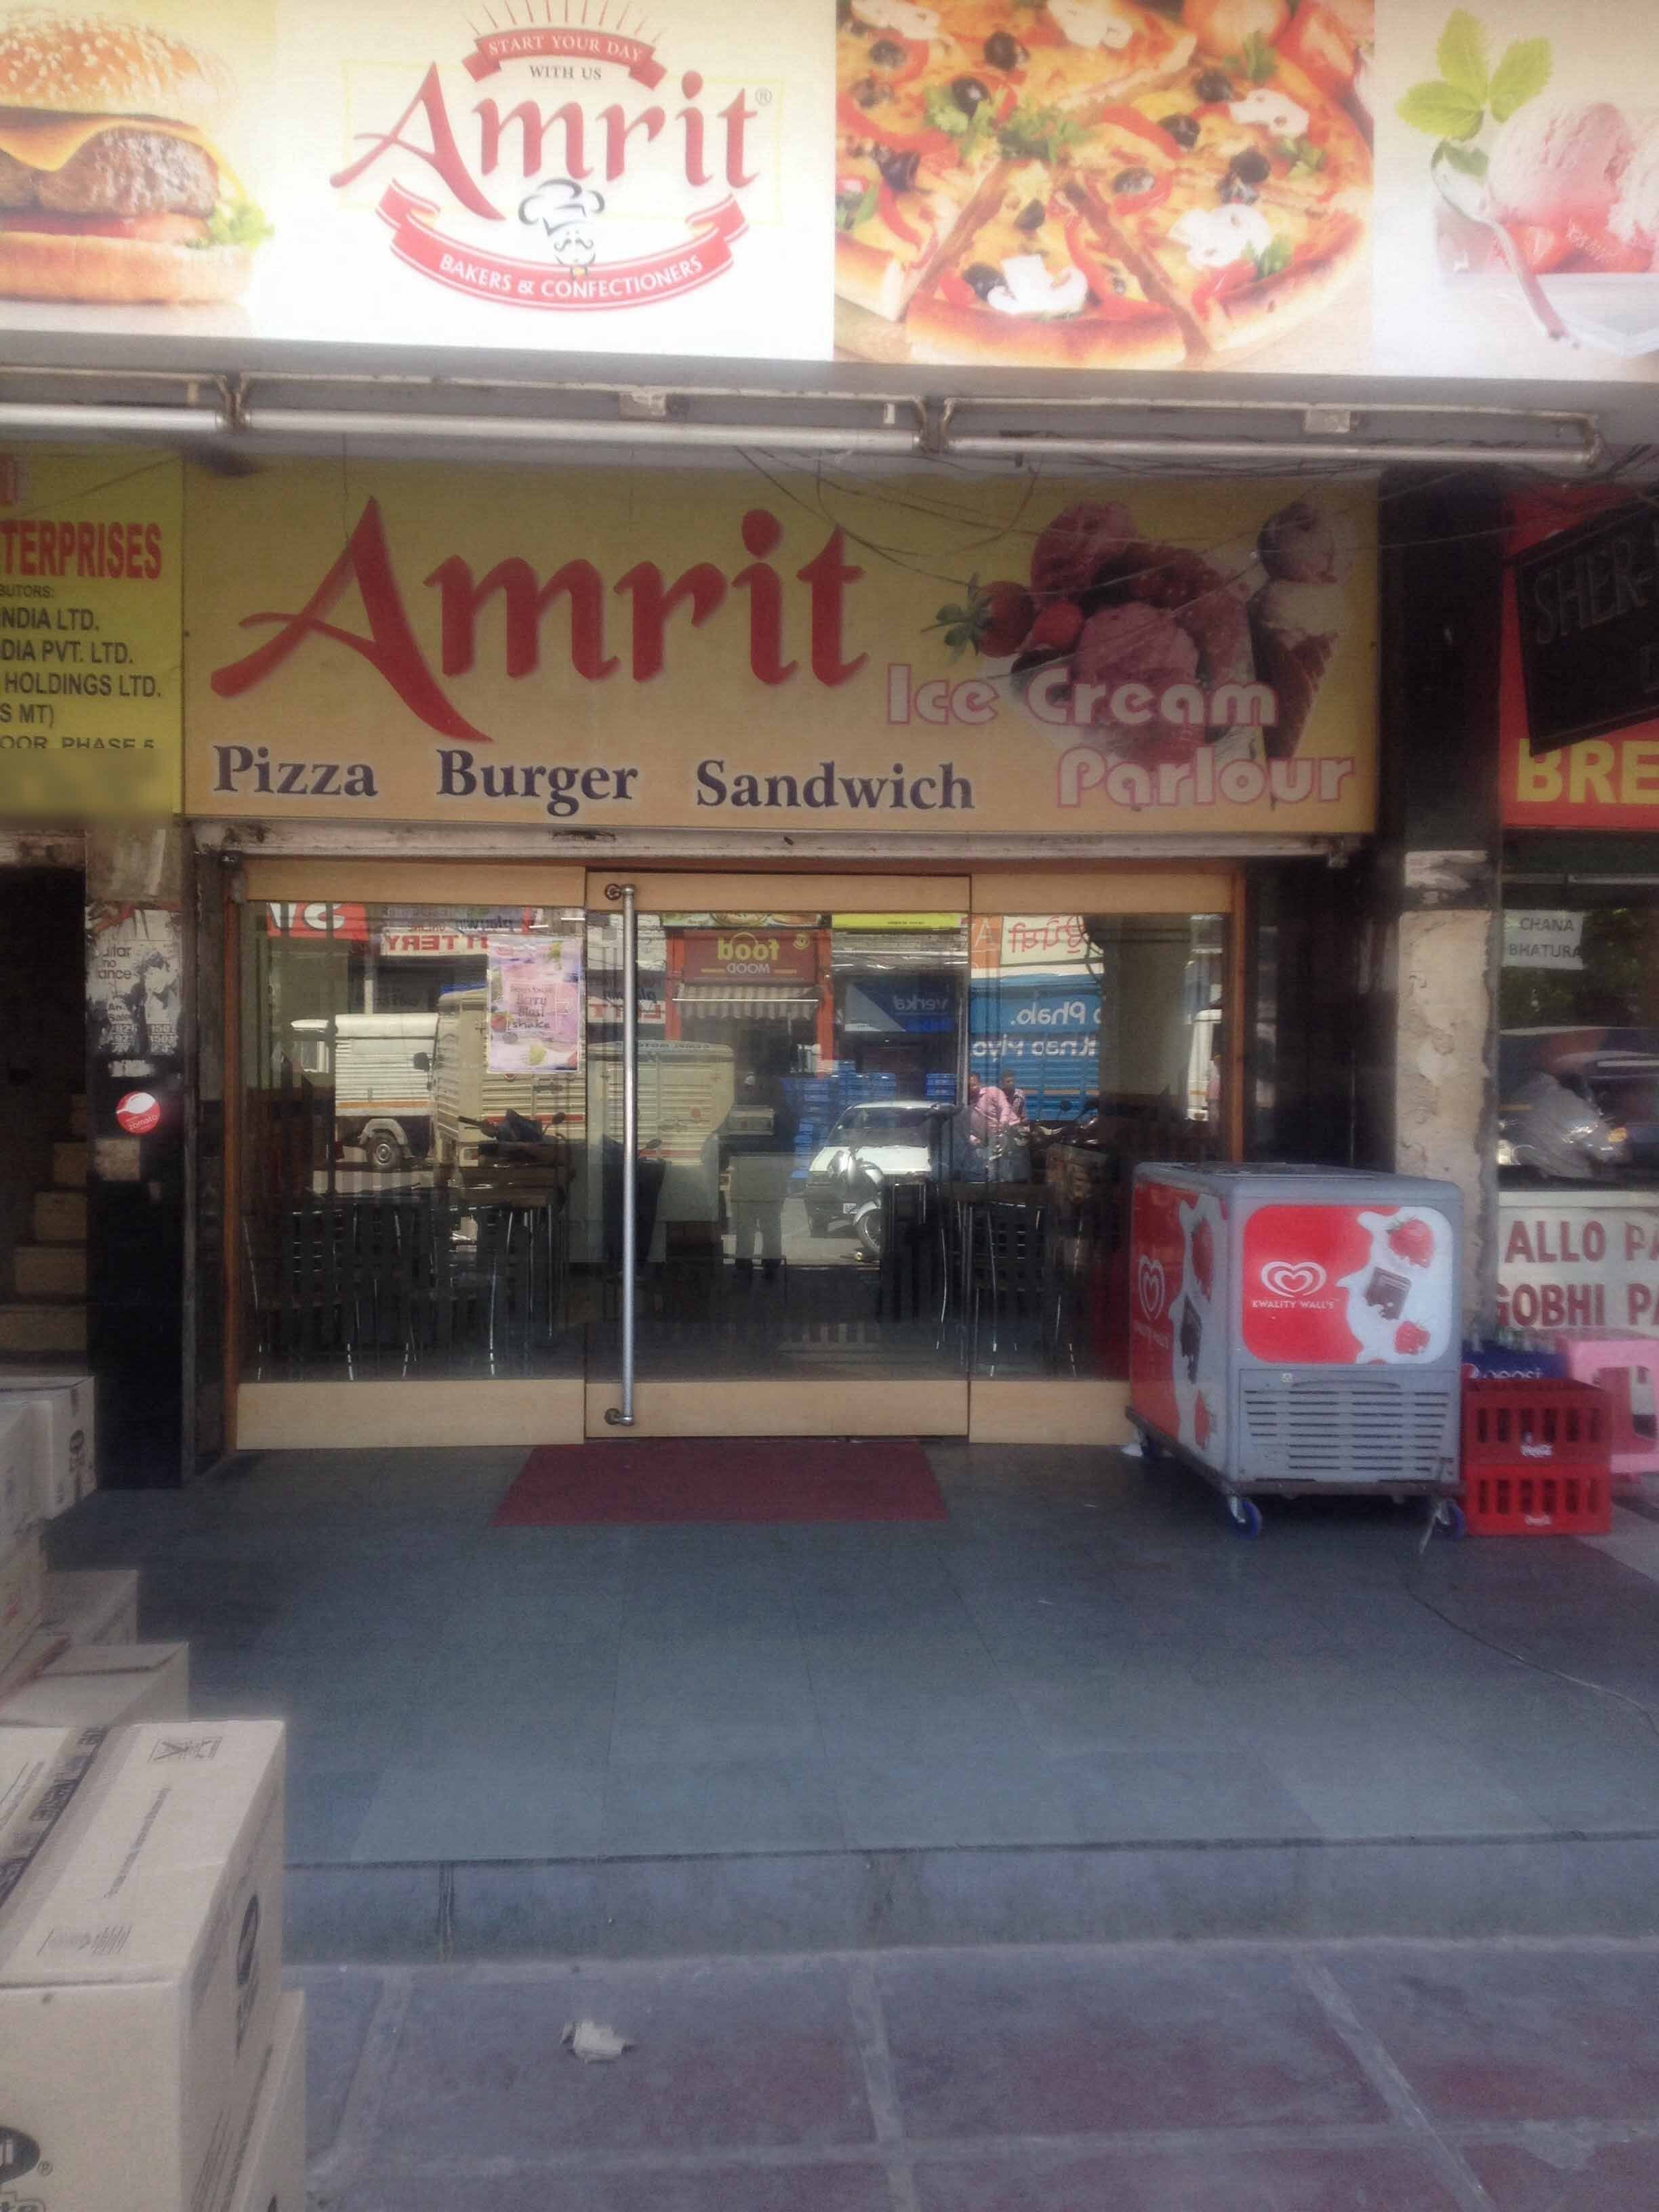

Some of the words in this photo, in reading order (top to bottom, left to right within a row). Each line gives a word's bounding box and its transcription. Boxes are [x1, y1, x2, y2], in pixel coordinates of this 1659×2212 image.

[488, 35, 544, 56] START
[552, 35, 601, 52] YOUR
[607, 41, 642, 61] DAY
[529, 64, 575, 79] WITH
[581, 66, 602, 81] US
[329, 61, 761, 221] Amrit
[438, 253, 512, 292] BAKERS
[517, 280, 534, 295] &
[541, 254, 703, 298] CONFECTIONERS
[57, 609, 100, 631] LTD.
[210, 495, 867, 743] Amrit
[42, 640, 83, 663] PVT.
[91, 642, 134, 664] LTD.
[4, 671, 112, 697] HOLDINGS
[119, 674, 162, 697] LTD.
[886, 663, 1000, 726] Ice
[1025, 665, 1279, 729] Cream
[19, 703, 54, 730] MT)
[213, 745, 379, 798] Pizza
[436, 748, 639, 817] Burger
[695, 759, 975, 810] Sandwich
[1057, 744, 1355, 811] Parlour
[1520, 917, 1575, 933] CHANA
[1504, 1219, 1607, 1264] ALLO
[1252, 1300, 1296, 1309] KWALITY
[1300, 1300, 1334, 1309] WALL'S
